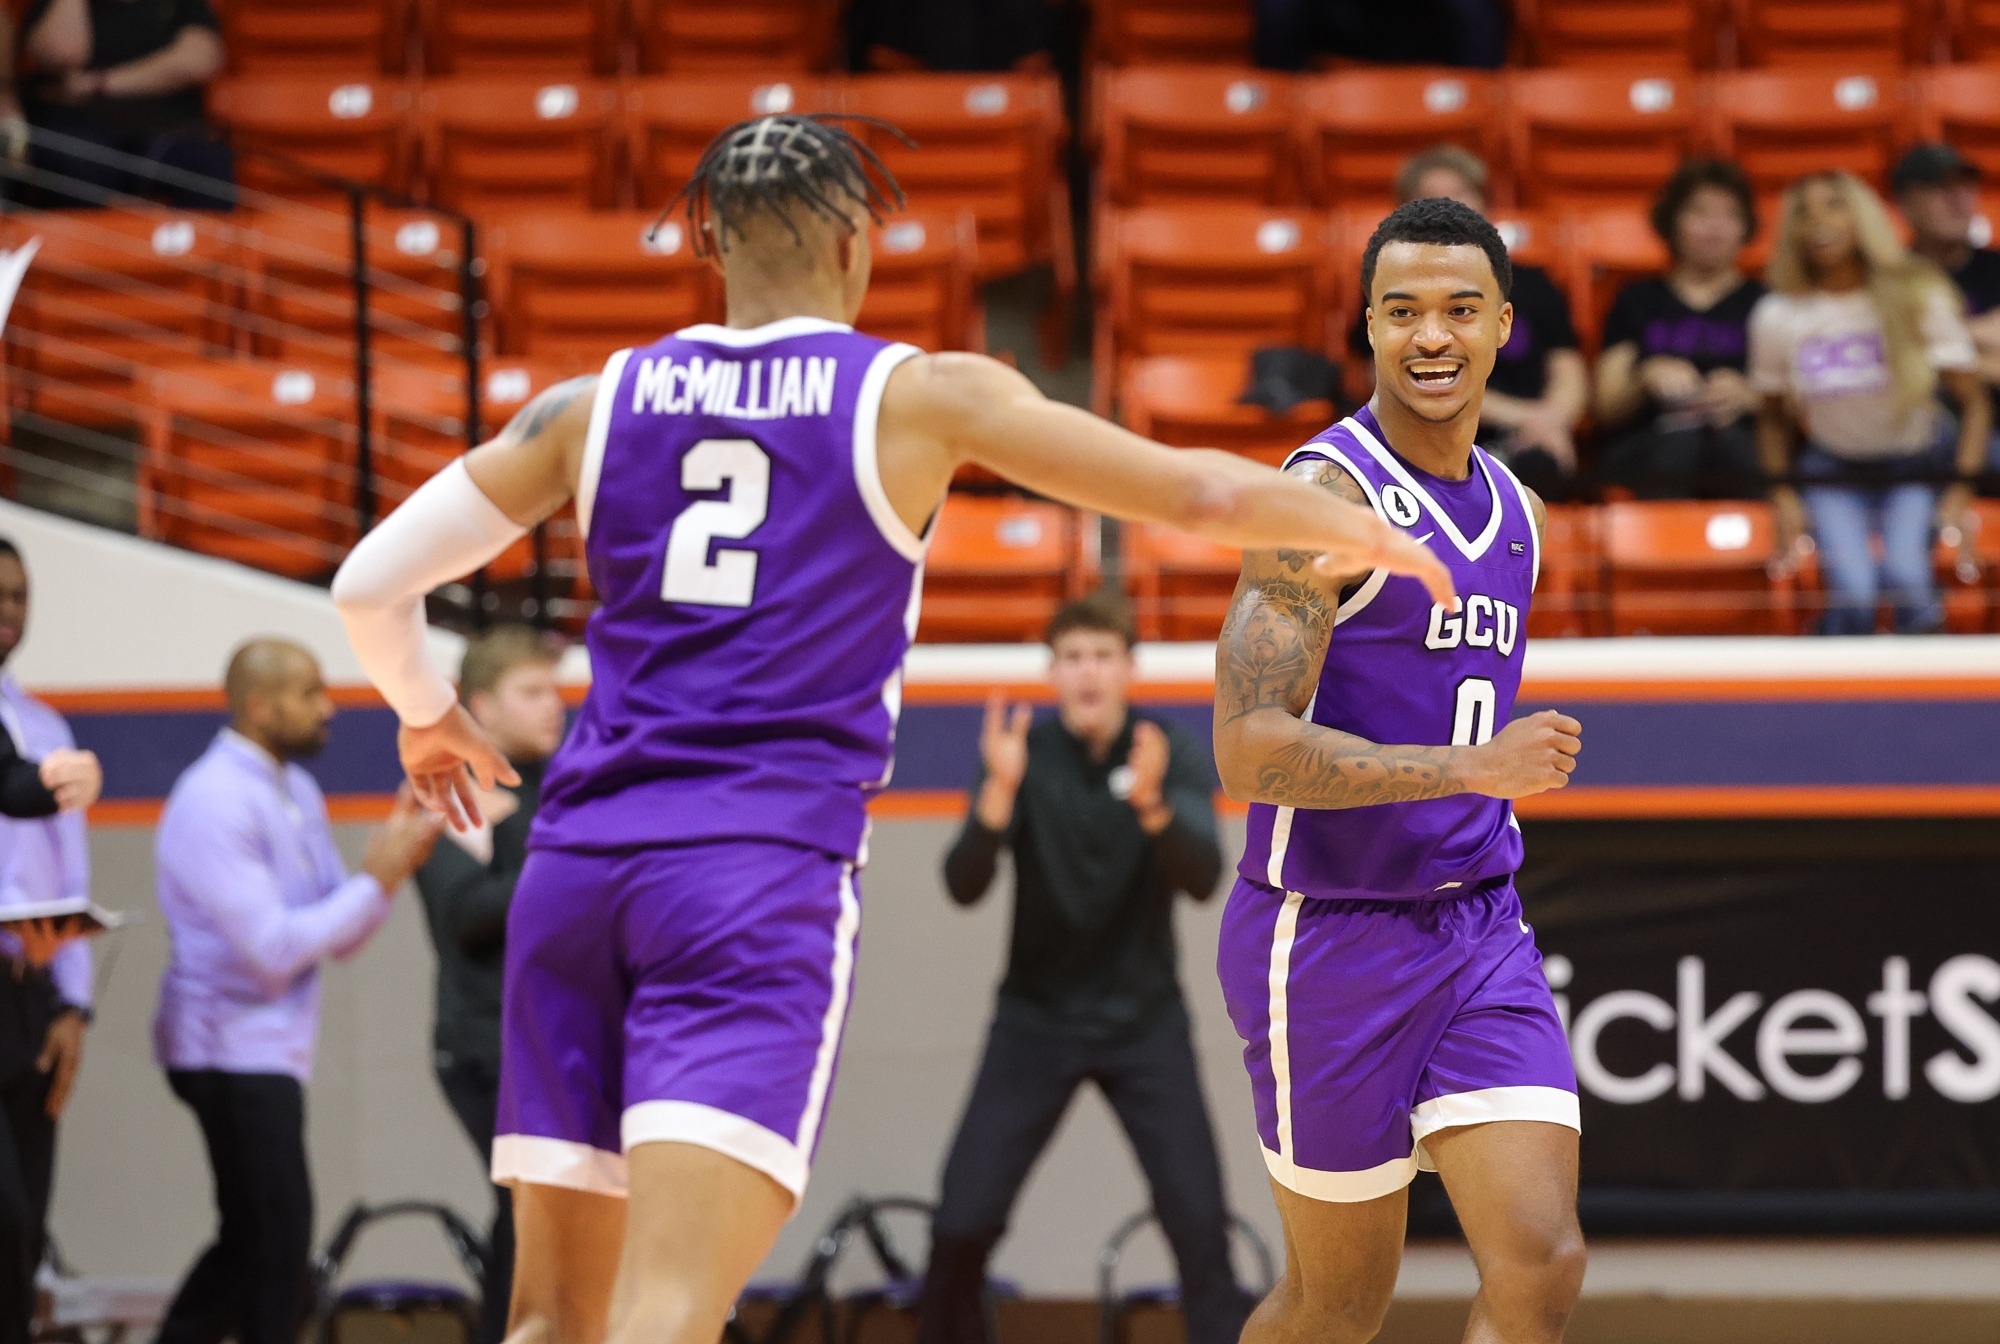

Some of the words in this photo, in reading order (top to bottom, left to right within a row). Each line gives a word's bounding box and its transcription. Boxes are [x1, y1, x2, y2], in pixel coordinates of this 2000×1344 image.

[632, 356, 837, 420] McMILLIAN
[660, 438, 771, 608] 2
[1393, 490, 1412, 519] 4
[1424, 593, 1519, 658] GCU
[1451, 676, 1496, 746] 0
